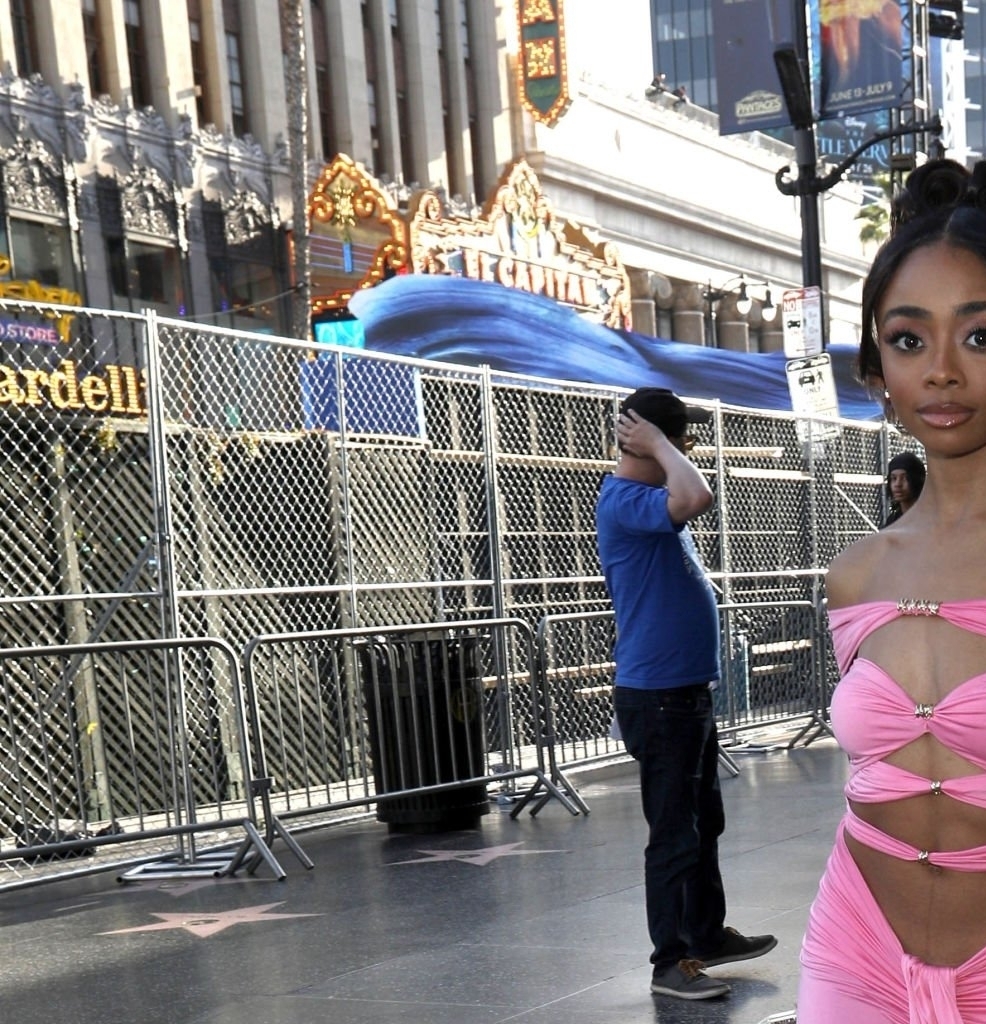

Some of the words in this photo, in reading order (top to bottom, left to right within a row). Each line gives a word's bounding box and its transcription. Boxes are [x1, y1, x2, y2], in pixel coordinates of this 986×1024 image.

[830, 89, 852, 103] JUNE
[783, 301, 797, 312] NO
[7, 323, 57, 344] STORE
